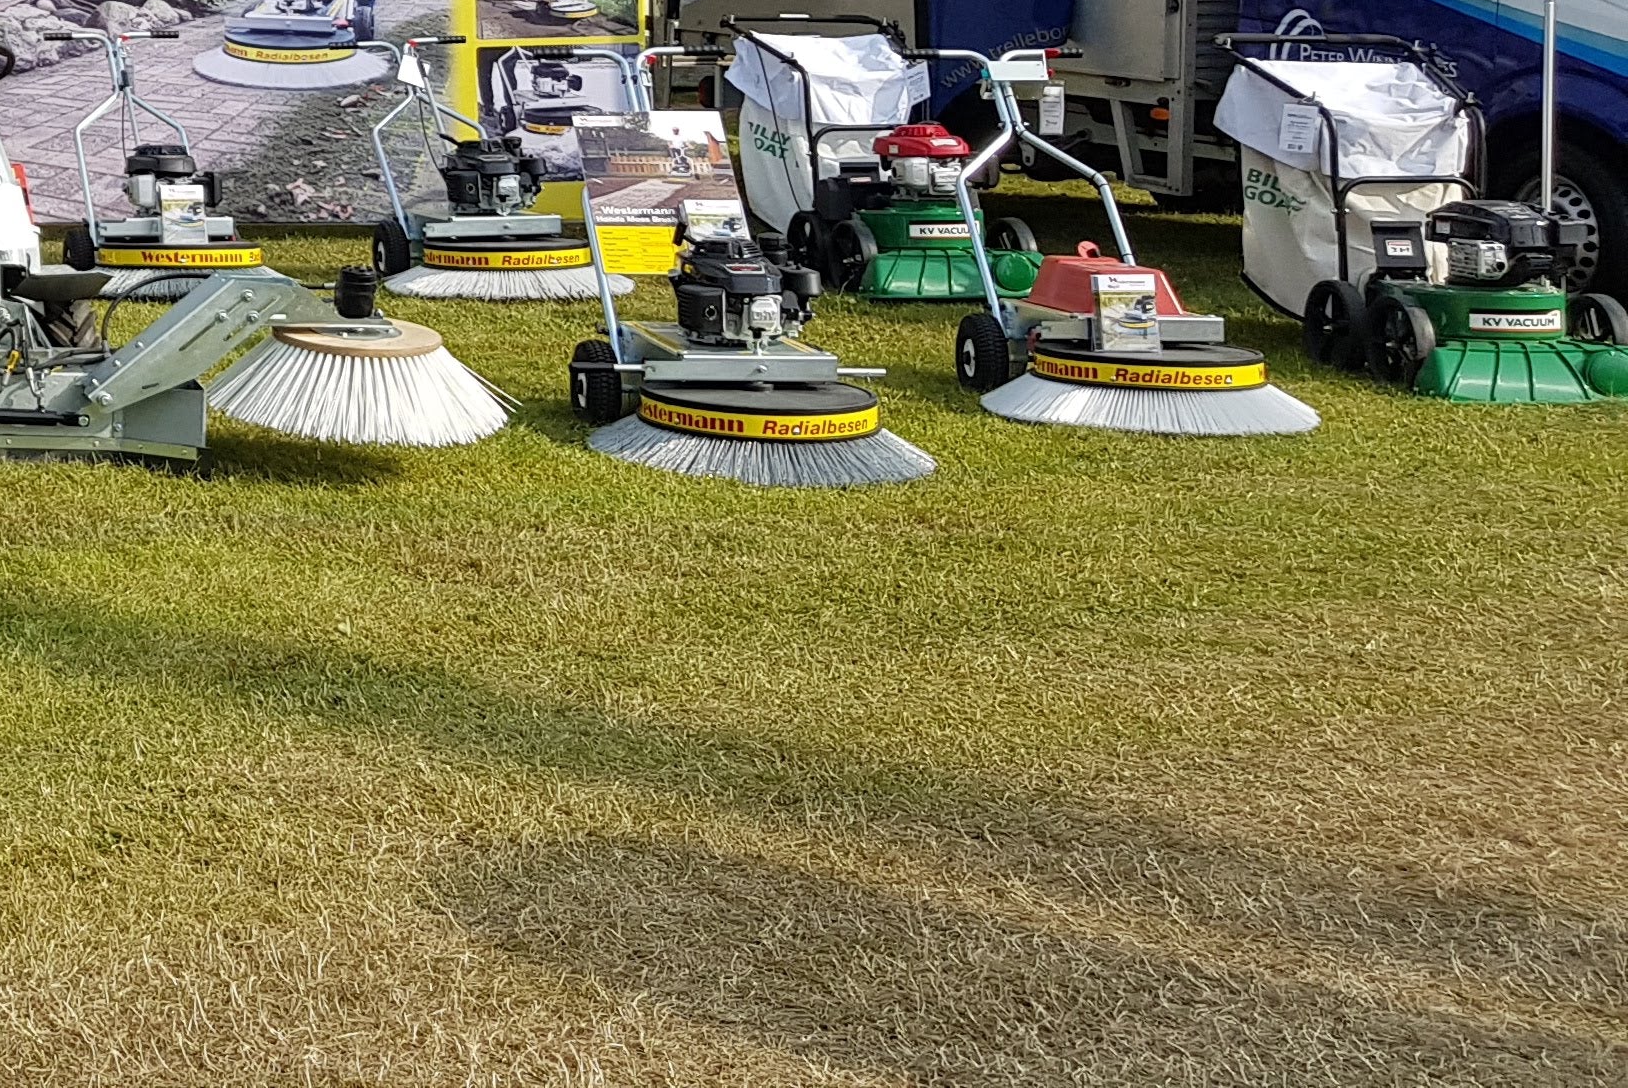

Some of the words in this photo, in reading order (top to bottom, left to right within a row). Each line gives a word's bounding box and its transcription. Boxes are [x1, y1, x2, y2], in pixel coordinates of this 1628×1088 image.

[747, 121, 791, 146] ILLY
[754, 137, 788, 159] OAT
[1246, 167, 1283, 192] BIL
[919, 227, 934, 235] KV
[140, 251, 243, 263] Westermann
[501, 254, 580, 266] Radialbesen
[1482, 317, 1502, 327] KV
[1505, 318, 1555, 327] VACUUM
[1034, 357, 1099, 379] ermann
[642, 401, 745, 433] estermann
[762, 418, 868, 436] Radialbesen
